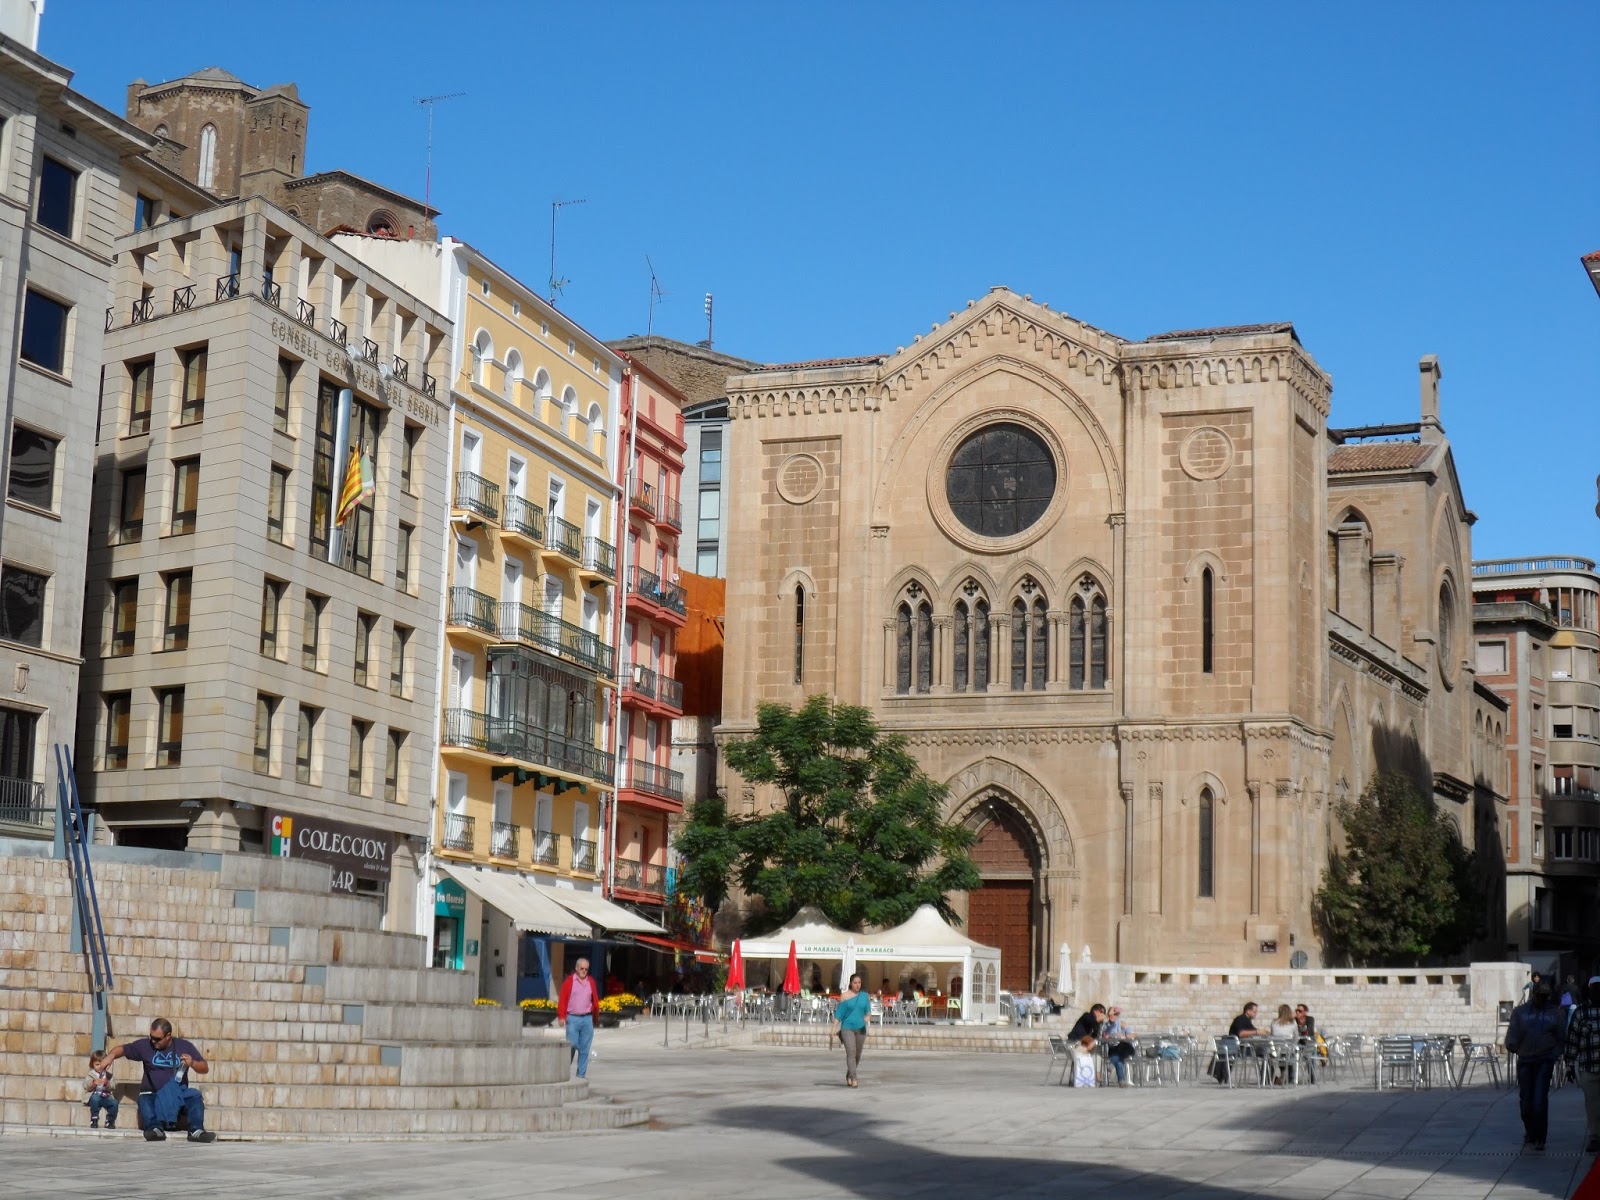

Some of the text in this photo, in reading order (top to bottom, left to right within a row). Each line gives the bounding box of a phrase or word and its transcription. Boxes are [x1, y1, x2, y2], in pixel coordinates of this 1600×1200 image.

[271, 317, 319, 358] CONSELL
[326, 348, 381, 393] COMRCAL
[385, 382, 403, 407] DEL
[299, 828, 387, 860] COLECCION
